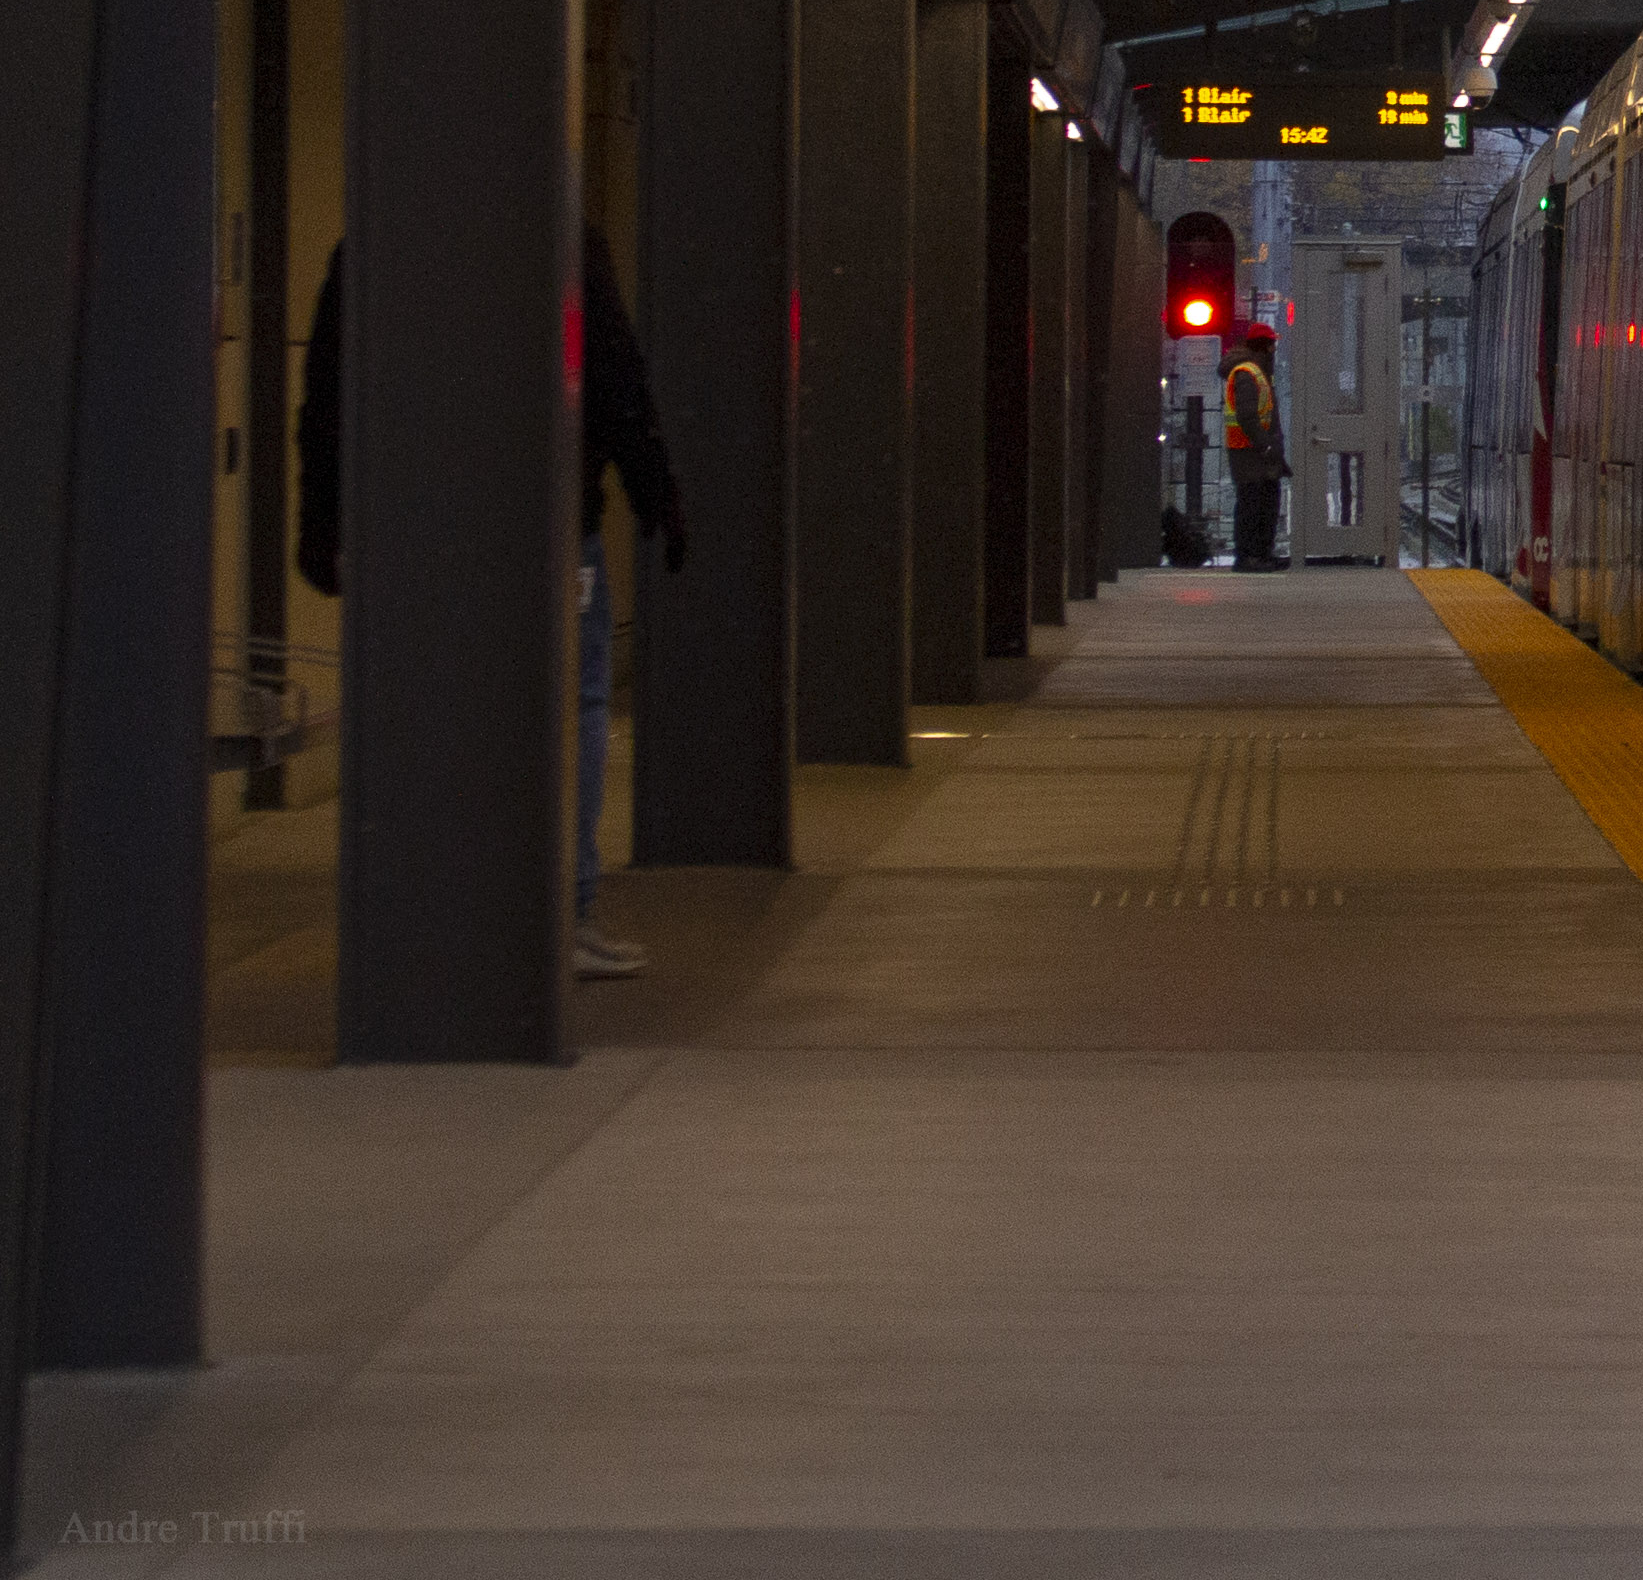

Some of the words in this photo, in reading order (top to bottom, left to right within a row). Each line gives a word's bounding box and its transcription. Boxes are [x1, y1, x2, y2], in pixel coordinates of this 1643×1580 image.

[1181, 87, 1193, 103] 1
[1198, 87, 1253, 104] Blair
[1181, 106, 1193, 123] 1
[1198, 106, 1251, 123] Blair
[1280, 127, 1328, 144] 15:42
